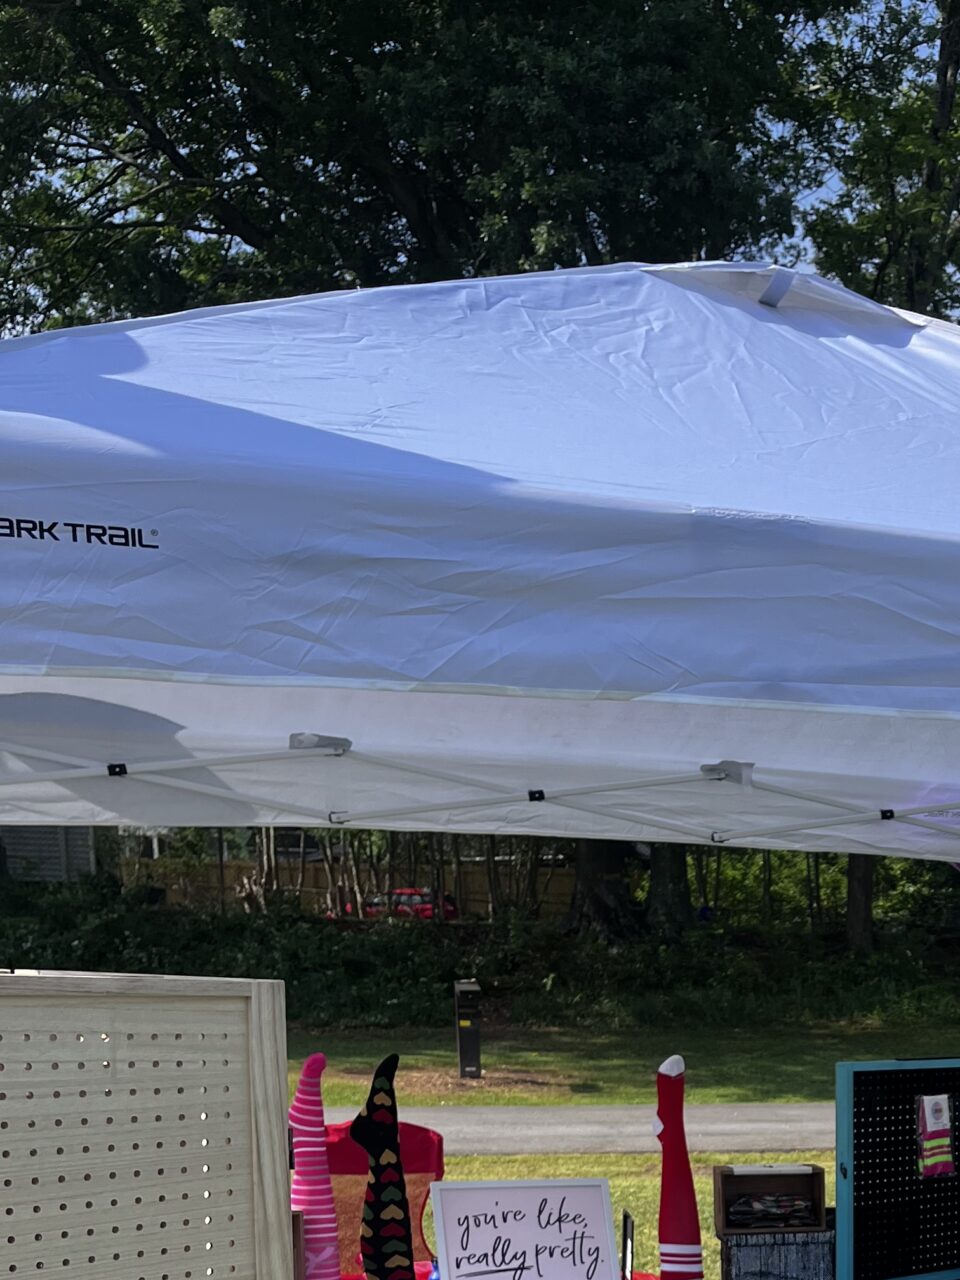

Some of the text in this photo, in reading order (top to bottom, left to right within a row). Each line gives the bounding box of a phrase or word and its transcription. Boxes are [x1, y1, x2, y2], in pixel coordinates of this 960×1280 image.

[457, 1196, 588, 1251] you're like,
[535, 1230, 605, 1280] pretty.
